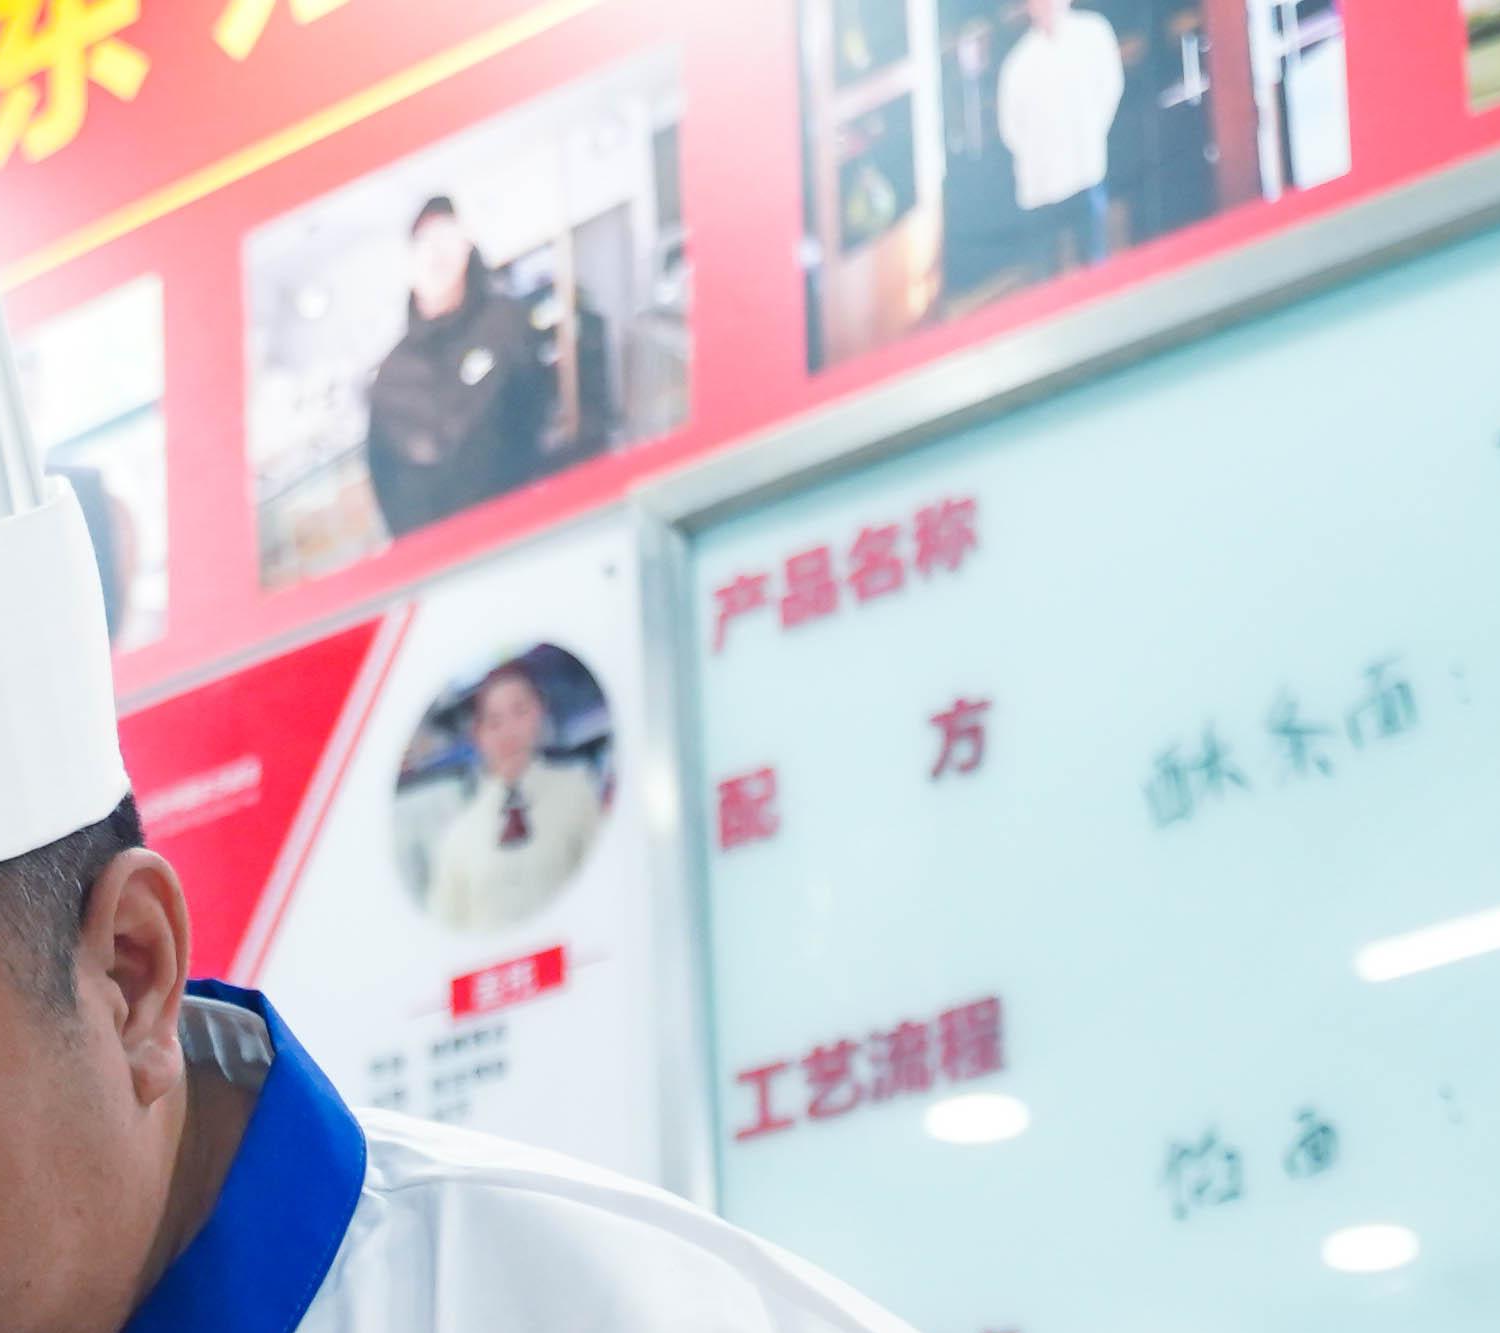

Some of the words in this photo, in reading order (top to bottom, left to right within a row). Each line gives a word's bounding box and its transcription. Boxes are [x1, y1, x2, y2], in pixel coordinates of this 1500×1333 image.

[708, 492, 982, 655] 产品名称
[730, 995, 1006, 1144] 工艺流程
